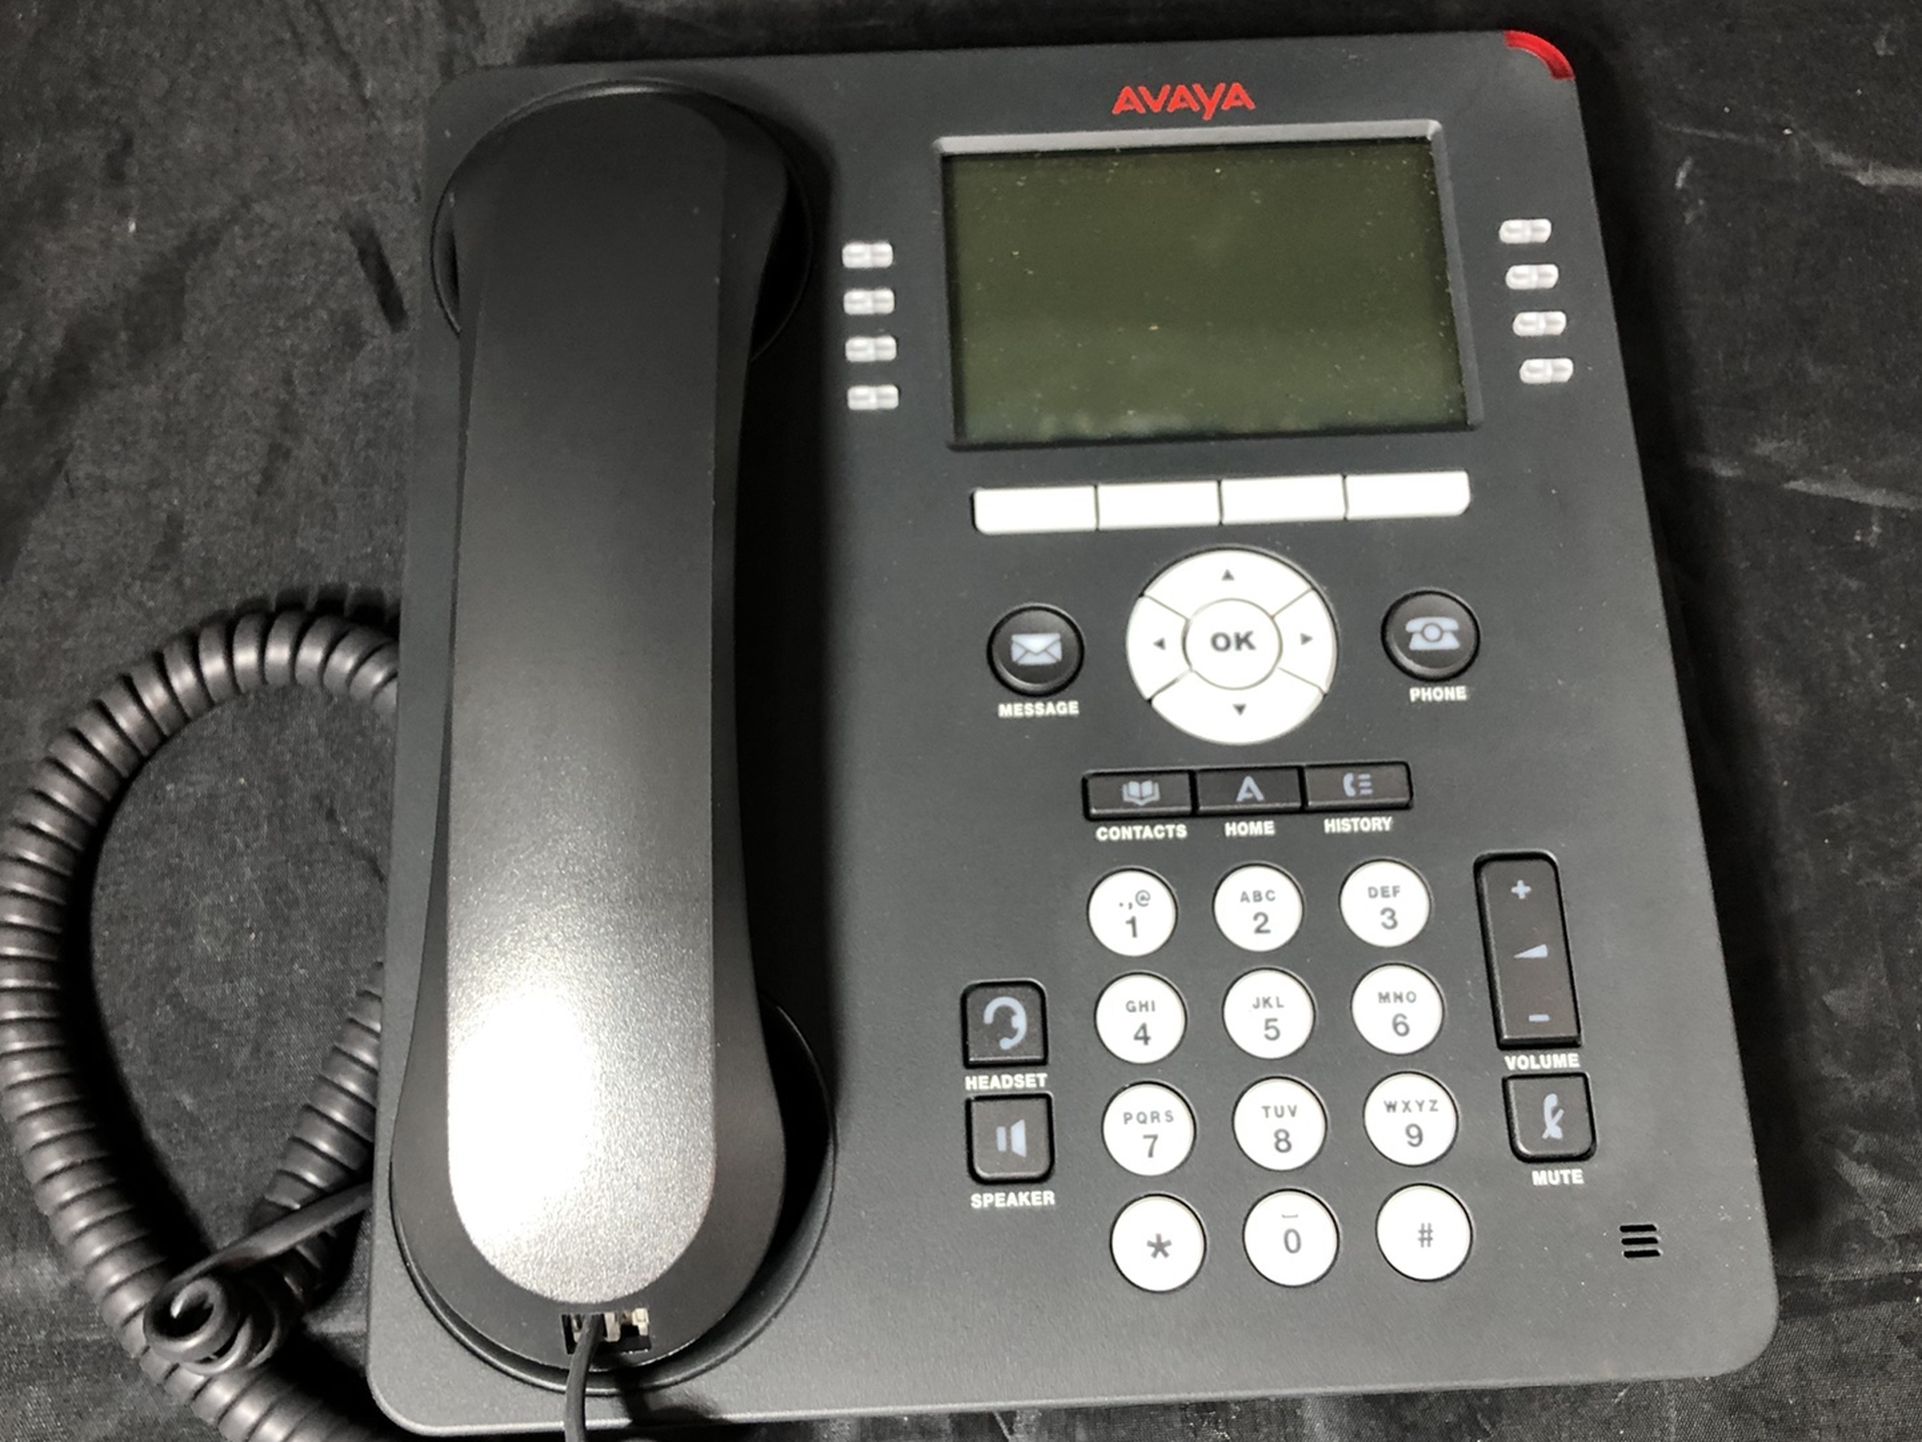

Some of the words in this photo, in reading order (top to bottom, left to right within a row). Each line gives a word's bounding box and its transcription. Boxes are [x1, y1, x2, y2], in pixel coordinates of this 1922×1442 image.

[1113, 83, 1254, 120] AVAYA
[1211, 631, 1256, 652] OK
[1410, 686, 1467, 702] PHONE
[998, 701, 1079, 717] MESSAGE
[1096, 824, 1187, 841] CONTACTS
[1225, 821, 1275, 837] HOME
[1324, 816, 1393, 833] HISTORY
[1240, 889, 1276, 903] ABC
[1368, 885, 1400, 899] DEF
[1126, 916, 1137, 938] 1
[1253, 912, 1271, 934] 2
[1380, 907, 1398, 930] 3
[1252, 996, 1284, 1009] JKL
[1378, 991, 1416, 1003] MNO
[1125, 1000, 1155, 1013] GHI
[1264, 1018, 1281, 1041] 5
[1392, 1013, 1410, 1037] 6
[1133, 1023, 1151, 1046] 4
[1504, 1053, 1580, 1070] VOLUME
[965, 1073, 1048, 1090] HEADSET
[1261, 1105, 1297, 1118] TUV
[1384, 1099, 1438, 1113] WXYZ
[1123, 1110, 1174, 1125] PQRS
[1274, 1129, 1292, 1153] 8
[1405, 1123, 1423, 1147] 9
[1143, 1134, 1158, 1158] 7
[1532, 1169, 1584, 1185] MUTE
[971, 1191, 1055, 1208] SPEAKER
[1284, 1229, 1301, 1254] 0
